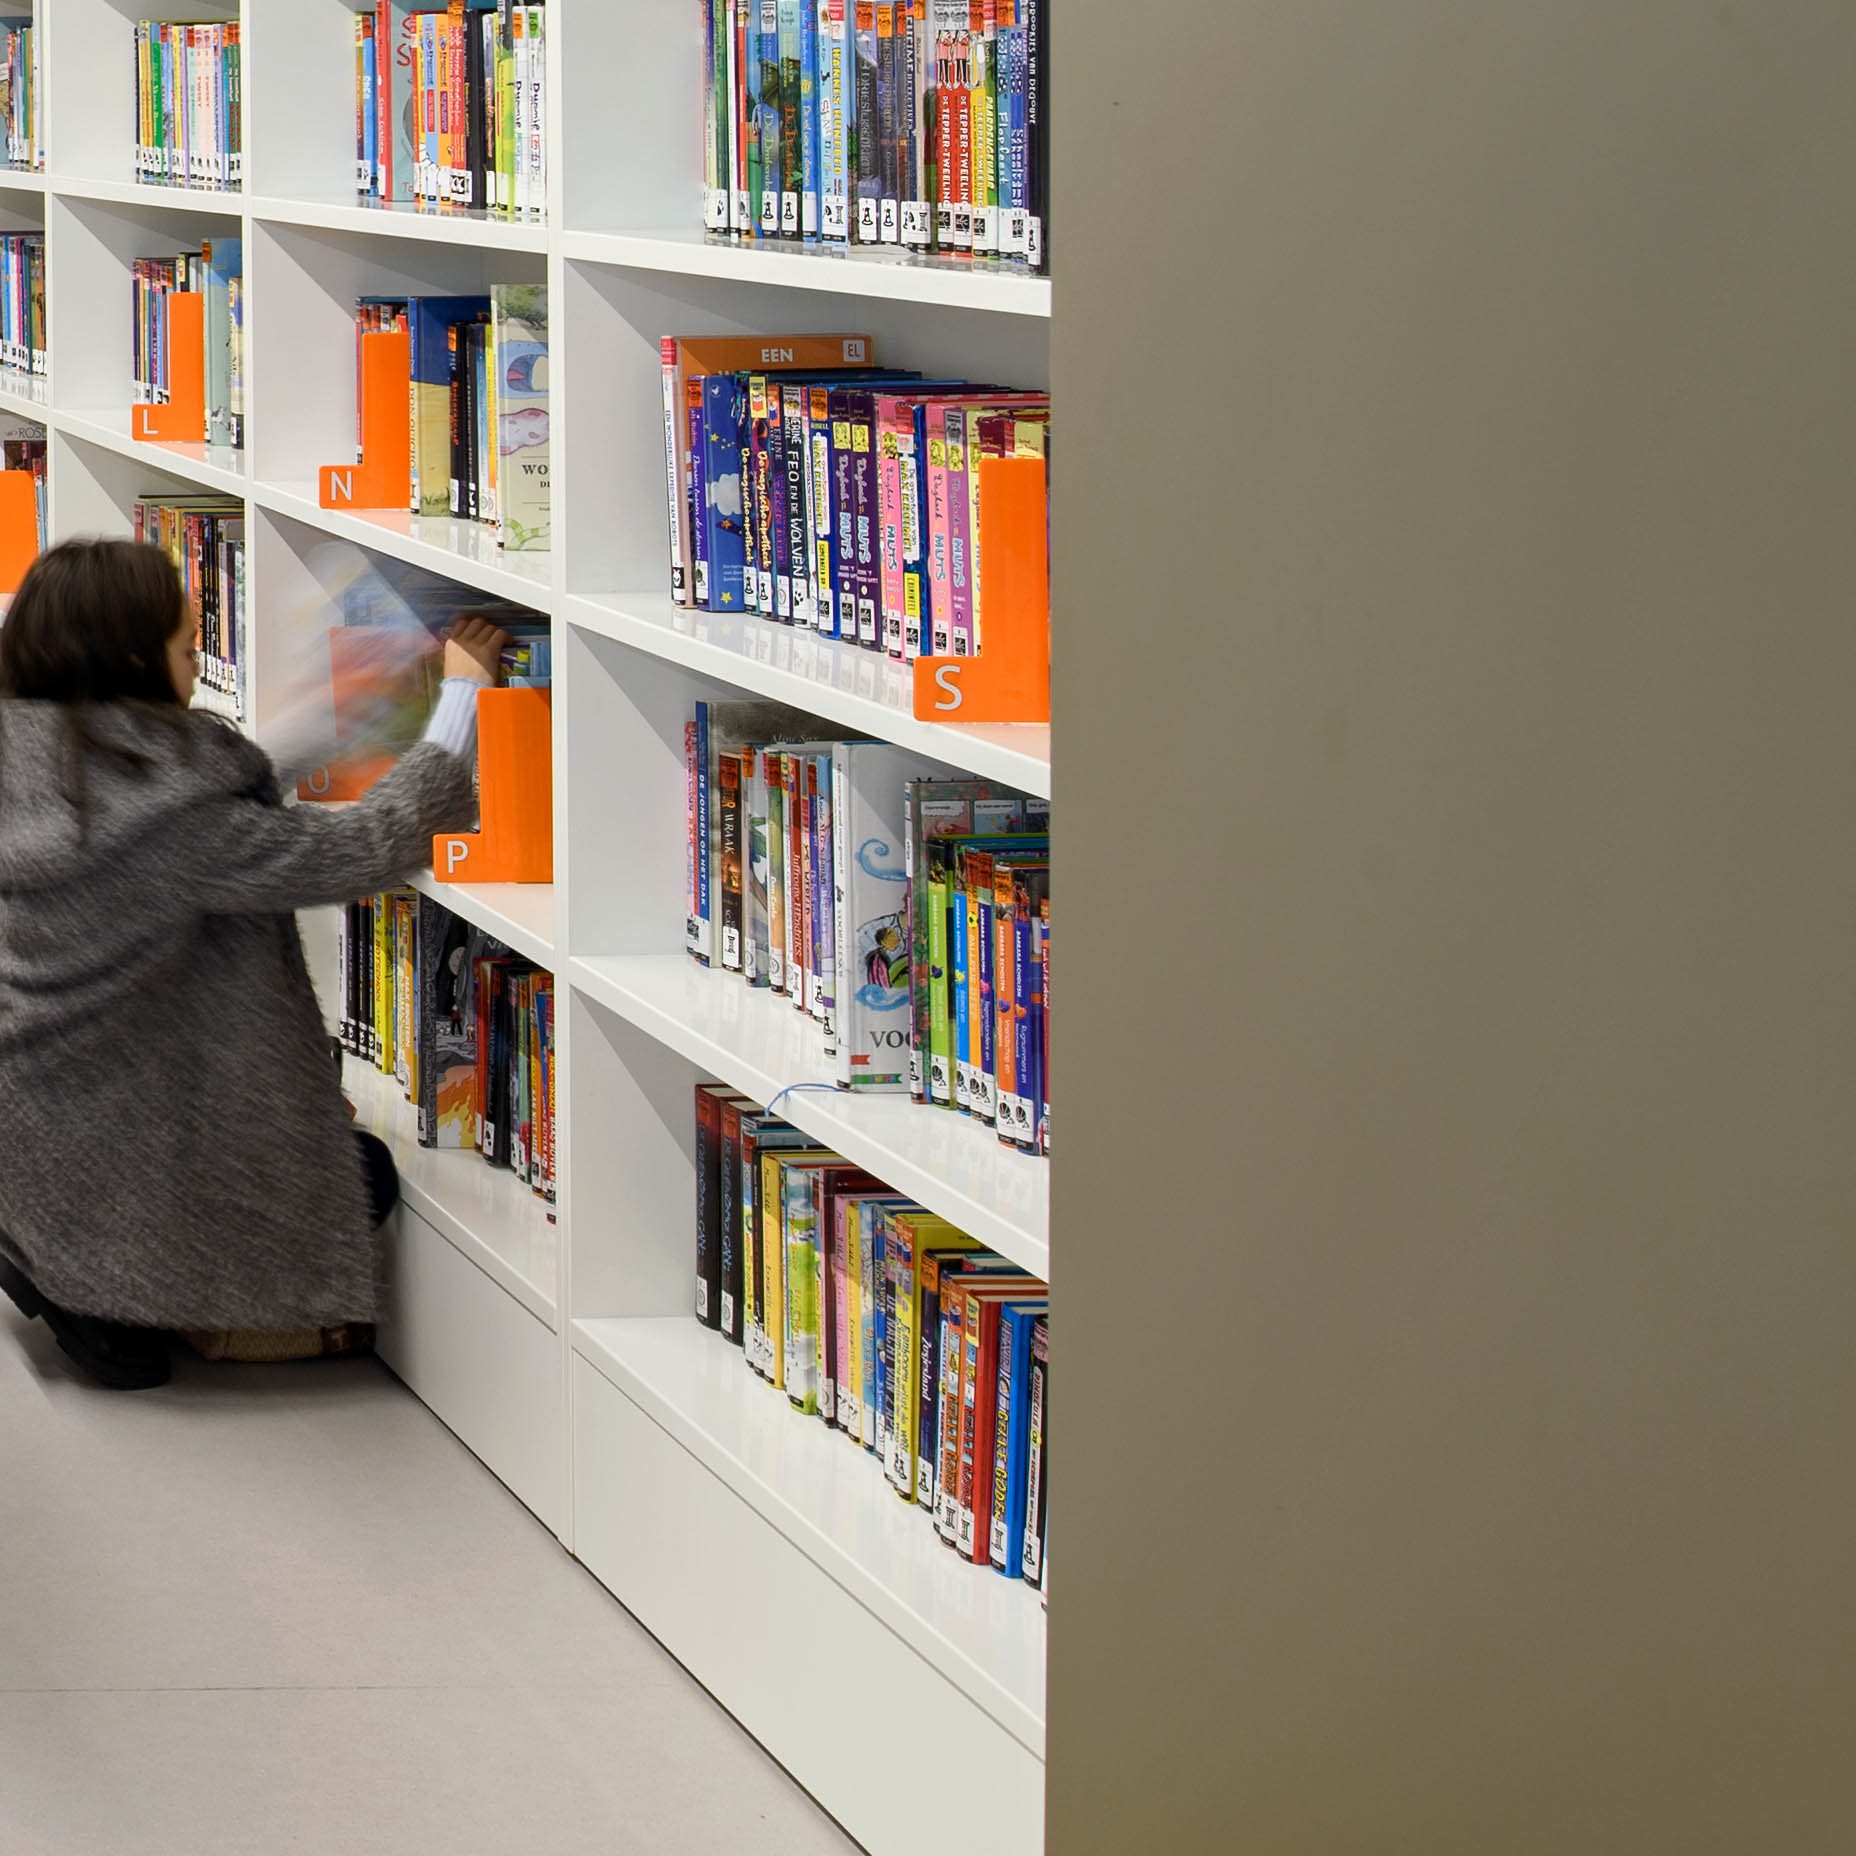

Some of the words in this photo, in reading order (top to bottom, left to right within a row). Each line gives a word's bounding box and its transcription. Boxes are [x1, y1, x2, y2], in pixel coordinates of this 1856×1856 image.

[761, 348, 794, 363] EEN
[847, 343, 862, 358] EL
[143, 412, 158, 435] L
[788, 451, 800, 482] FEO
[330, 471, 353, 501] N
[790, 486, 799, 501] EN
[790, 503, 799, 517] DE
[790, 517, 804, 577] WOLVEN
[840, 511, 853, 560] MUTS
[858, 515, 871, 565] MUTS
[888, 525, 898, 570] MUTS
[935, 533, 946, 581] MUTS
[953, 537, 965, 588] MUTS
[934, 665, 962, 710] S
[307, 761, 331, 795] O
[699, 774, 706, 789] DE
[699, 792, 707, 836] JONGEN
[699, 839, 707, 855] OP
[724, 813, 735, 855] WRAAK
[447, 841, 469, 873] P
[699, 858, 707, 881] HET
[791, 851, 802, 901] Juffrouw
[699, 883, 707, 906] DAK
[1015, 930, 1023, 962] BARBARA
[1015, 963, 1023, 997] SCHOLTEN
